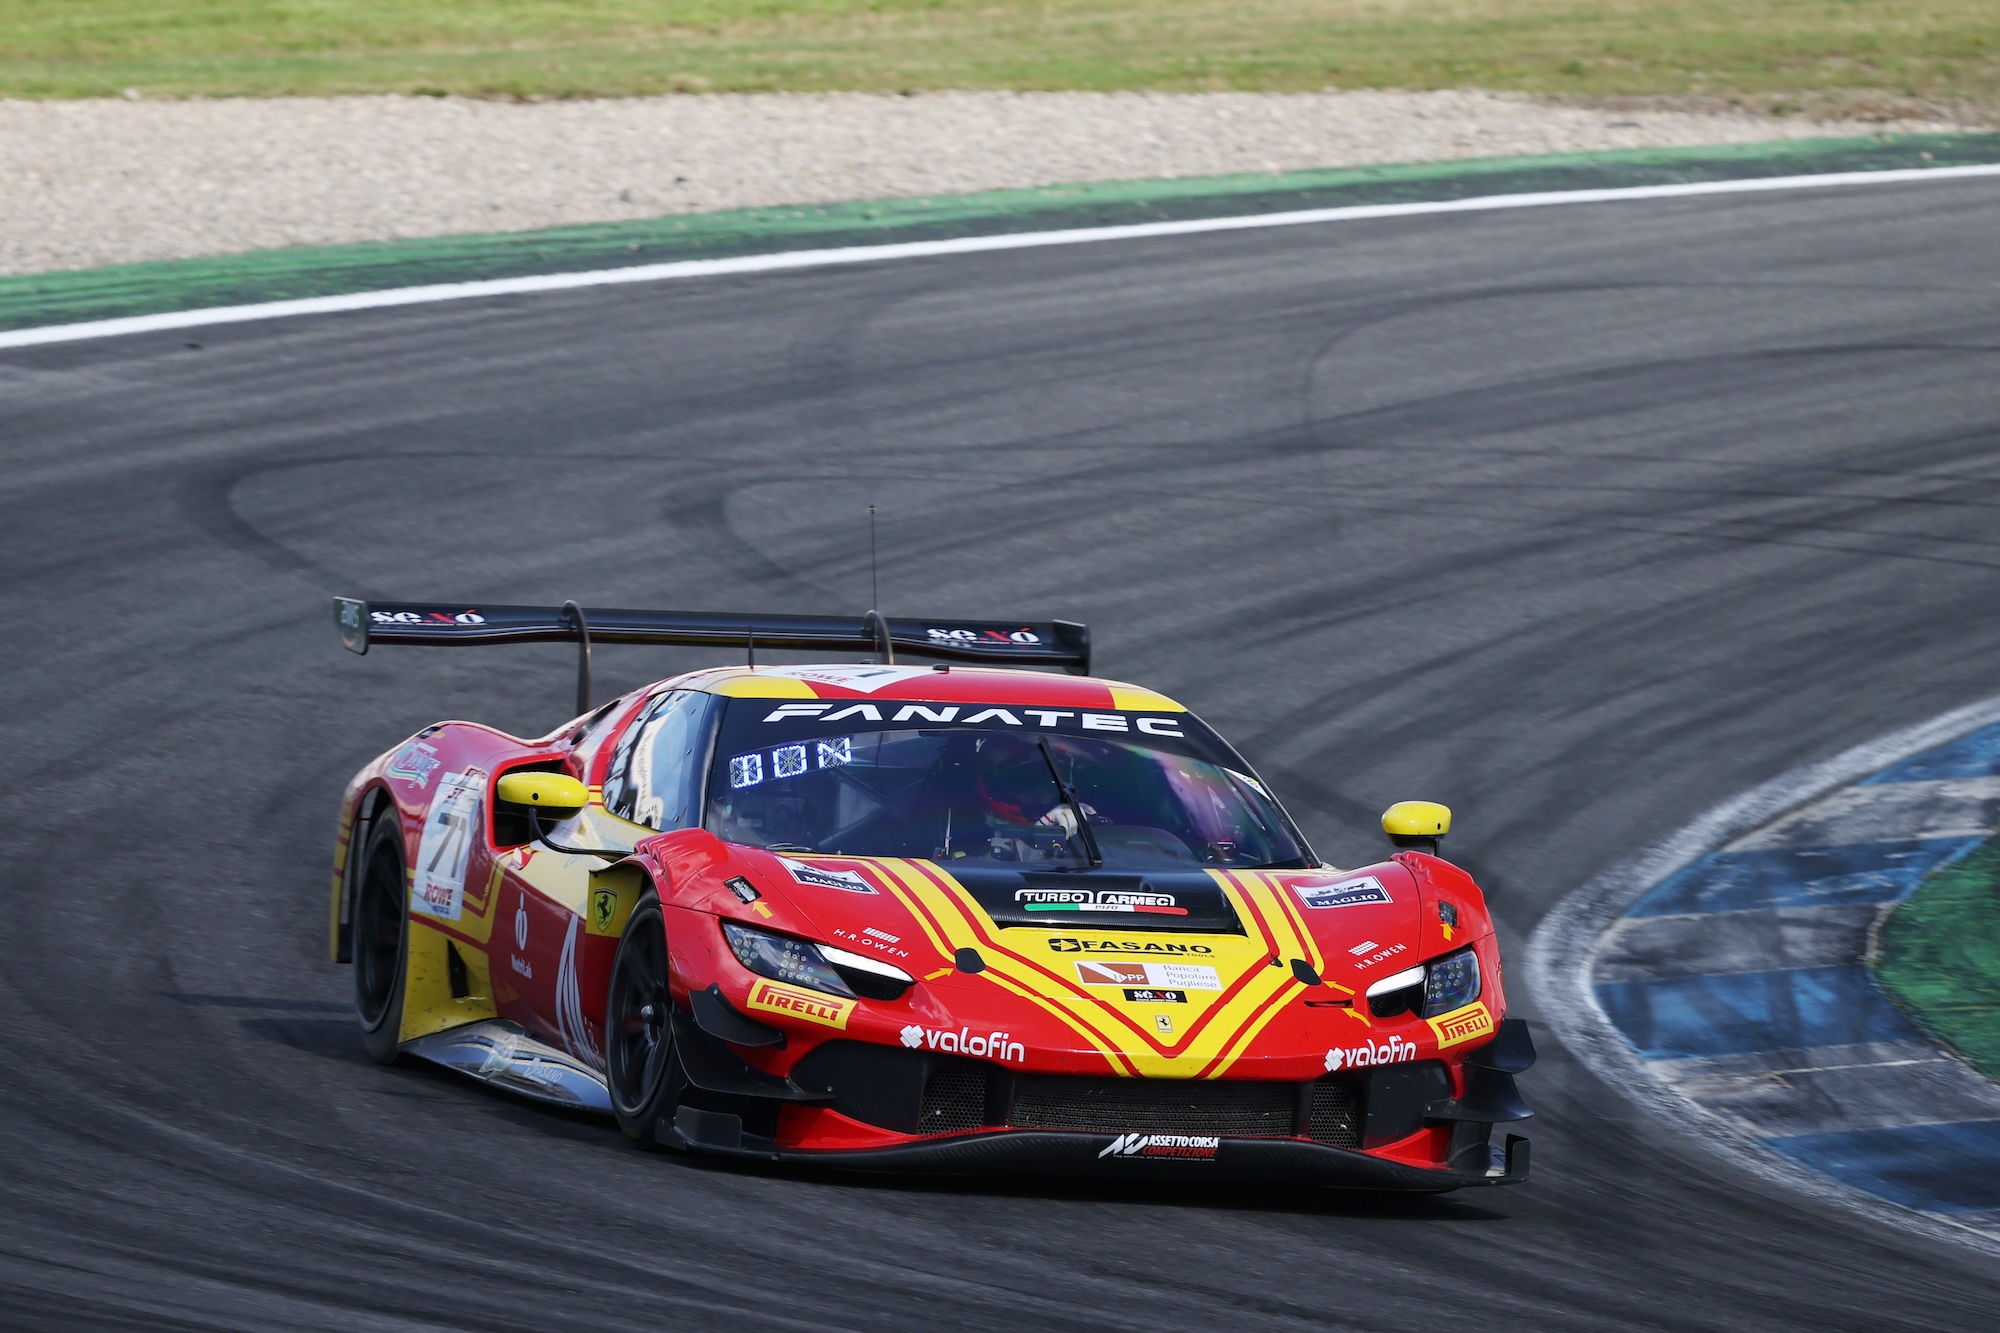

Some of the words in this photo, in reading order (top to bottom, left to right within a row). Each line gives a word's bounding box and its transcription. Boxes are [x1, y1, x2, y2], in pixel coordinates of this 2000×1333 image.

[762, 703, 1185, 738] FANATEC
[427, 811, 467, 878] 71
[803, 875, 864, 891] MAGLIO
[423, 882, 453, 906] ROWE
[1024, 893, 1085, 903] TURBO
[1105, 895, 1169, 906] ARMEC
[1316, 893, 1378, 906] MAGLIO
[1080, 940, 1212, 954] FASANO
[1163, 964, 1199, 972] Banca
[1166, 971, 1217, 980] Popolare
[1168, 979, 1217, 988] Pugliese
[756, 984, 844, 1022] PIRELLI
[1436, 1007, 1489, 1042] PIRELLI
[926, 1026, 1026, 1063] valofin
[1345, 1035, 1417, 1068] valofin
[1148, 1134, 1189, 1147] ASSETTO
[1142, 1146, 1218, 1158] COMPETIZIONE
